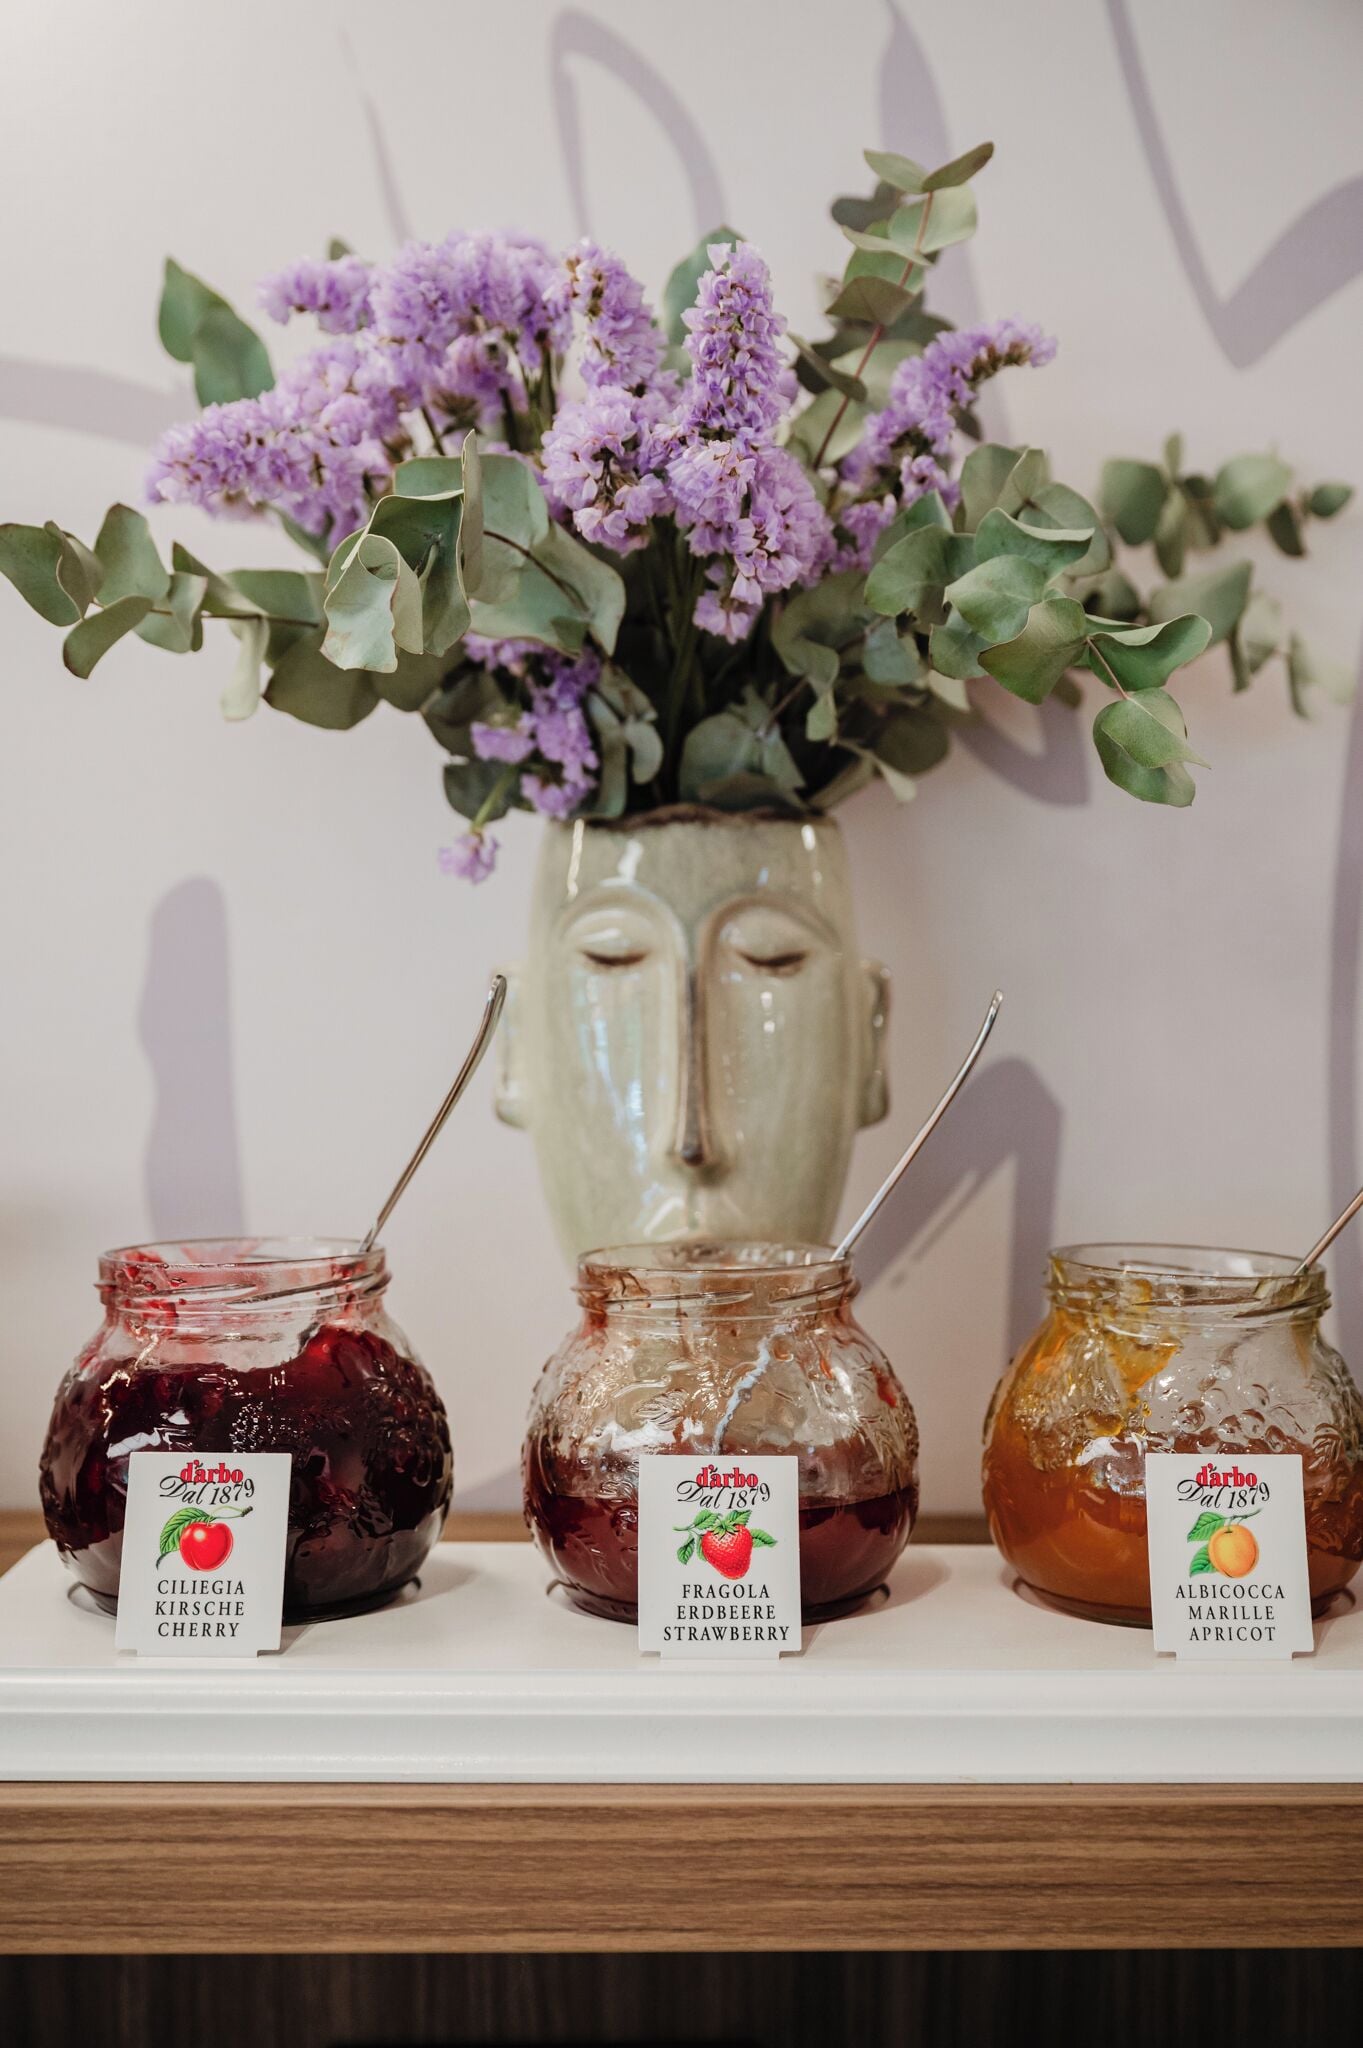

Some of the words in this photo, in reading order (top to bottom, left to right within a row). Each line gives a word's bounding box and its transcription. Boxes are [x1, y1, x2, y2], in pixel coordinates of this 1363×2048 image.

[159, 1475, 216, 1505] Dal
[209, 1478, 255, 1505] 1879
[676, 1480, 732, 1509] Dal
[727, 1482, 771, 1509] 1879
[1177, 1479, 1232, 1509] Dal
[1227, 1481, 1271, 1509] 1879
[157, 1579, 245, 1595] CILIEGIA
[682, 1583, 770, 1599] FRAGOLA
[1175, 1584, 1285, 1599] ALBICOCCA
[155, 1601, 244, 1616] KIRSCHE
[677, 1605, 776, 1620] ERDBEERE
[1188, 1605, 1275, 1620] MARILLE
[157, 1622, 240, 1638] CHERRY
[663, 1626, 790, 1642] STRAWBERRY
[1189, 1626, 1276, 1642] APRICOT
